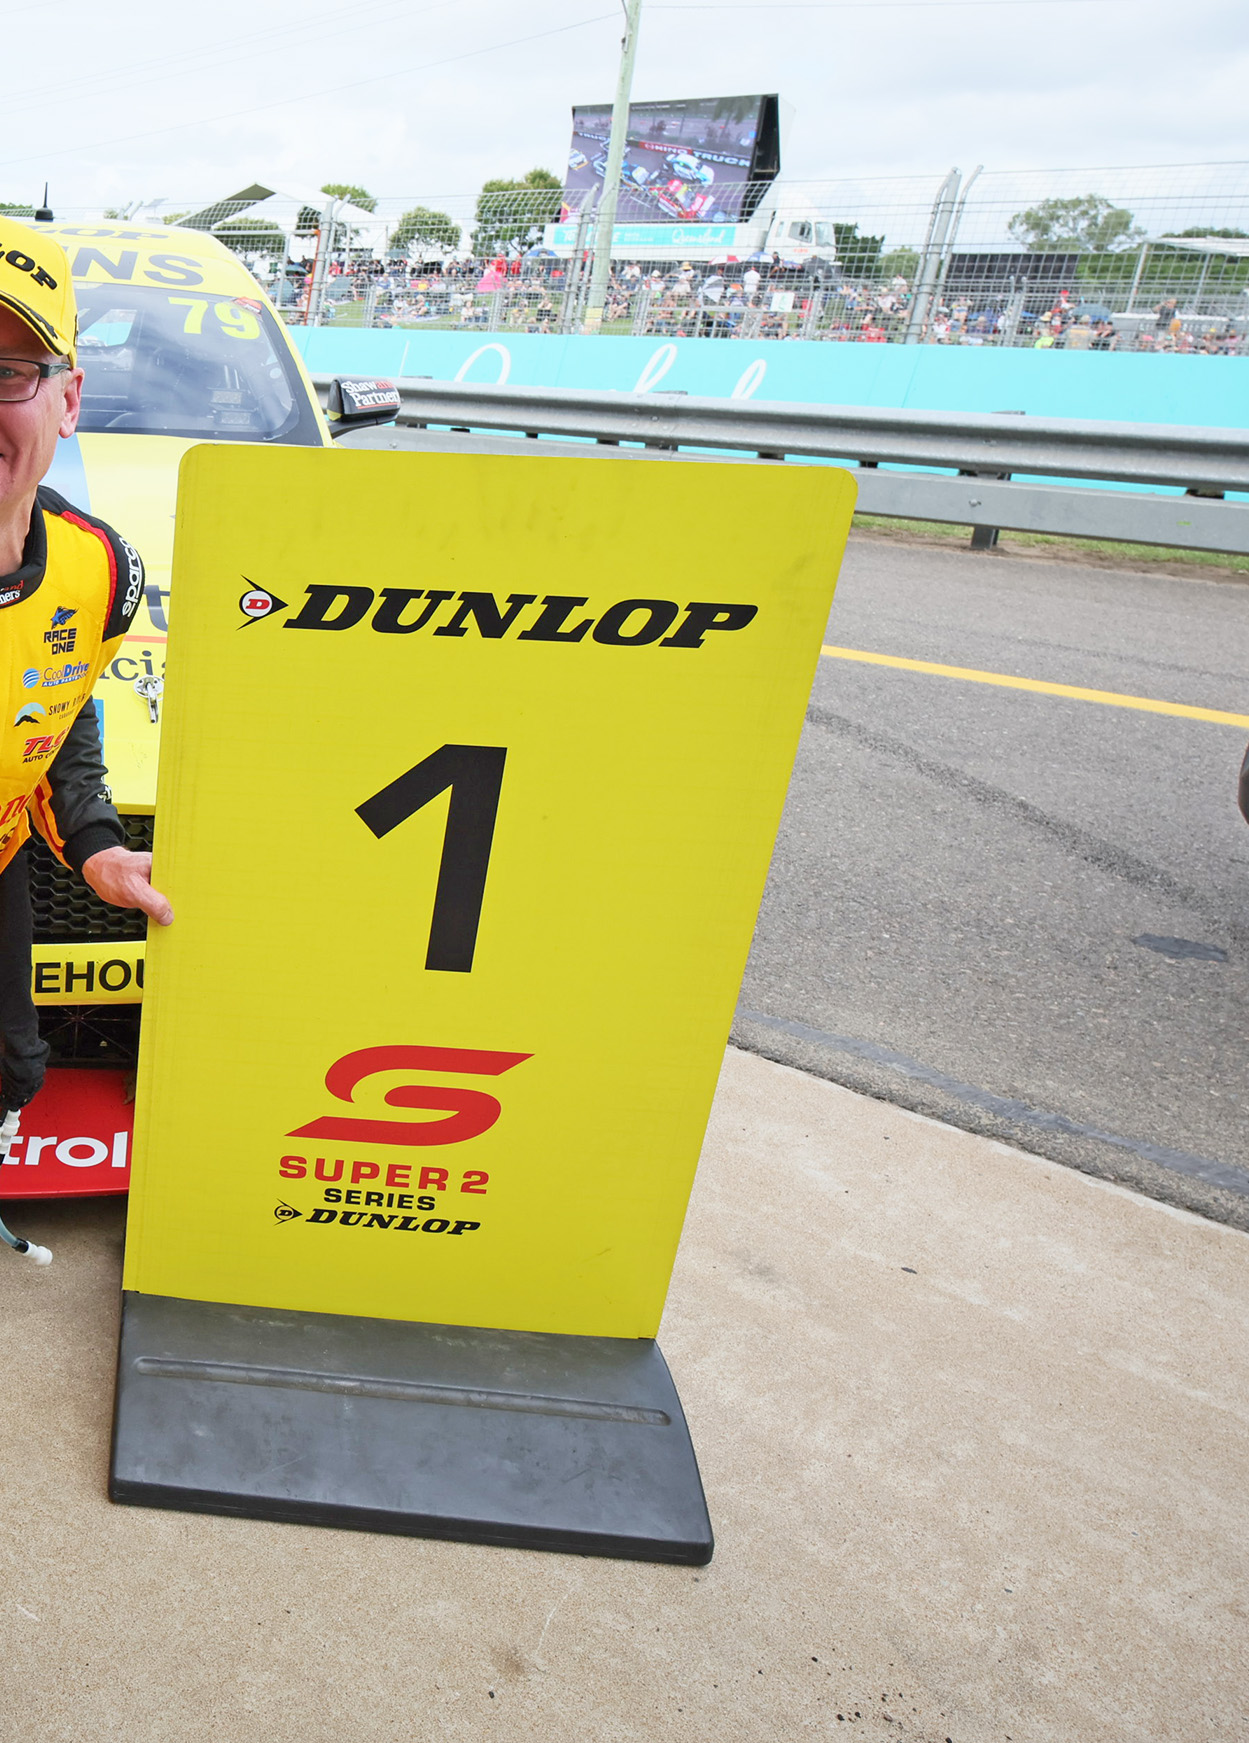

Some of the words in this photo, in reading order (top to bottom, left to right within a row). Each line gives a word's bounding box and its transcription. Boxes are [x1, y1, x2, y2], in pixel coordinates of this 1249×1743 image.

[694, 152, 750, 168] TRUCK
[167, 297, 260, 340] 79
[282, 584, 759, 649] DUNLOP
[44, 628, 77, 643] RACE
[52, 641, 75, 655] ONE
[49, 701, 70, 715] SNOWY
[23, 755, 43, 763] AUTO
[354, 743, 508, 973] 1
[278, 1155, 449, 1191] SUPER
[460, 1170, 490, 1194] 2
[323, 1187, 436, 1211] SERIES
[305, 1208, 481, 1235] DUNLOP
